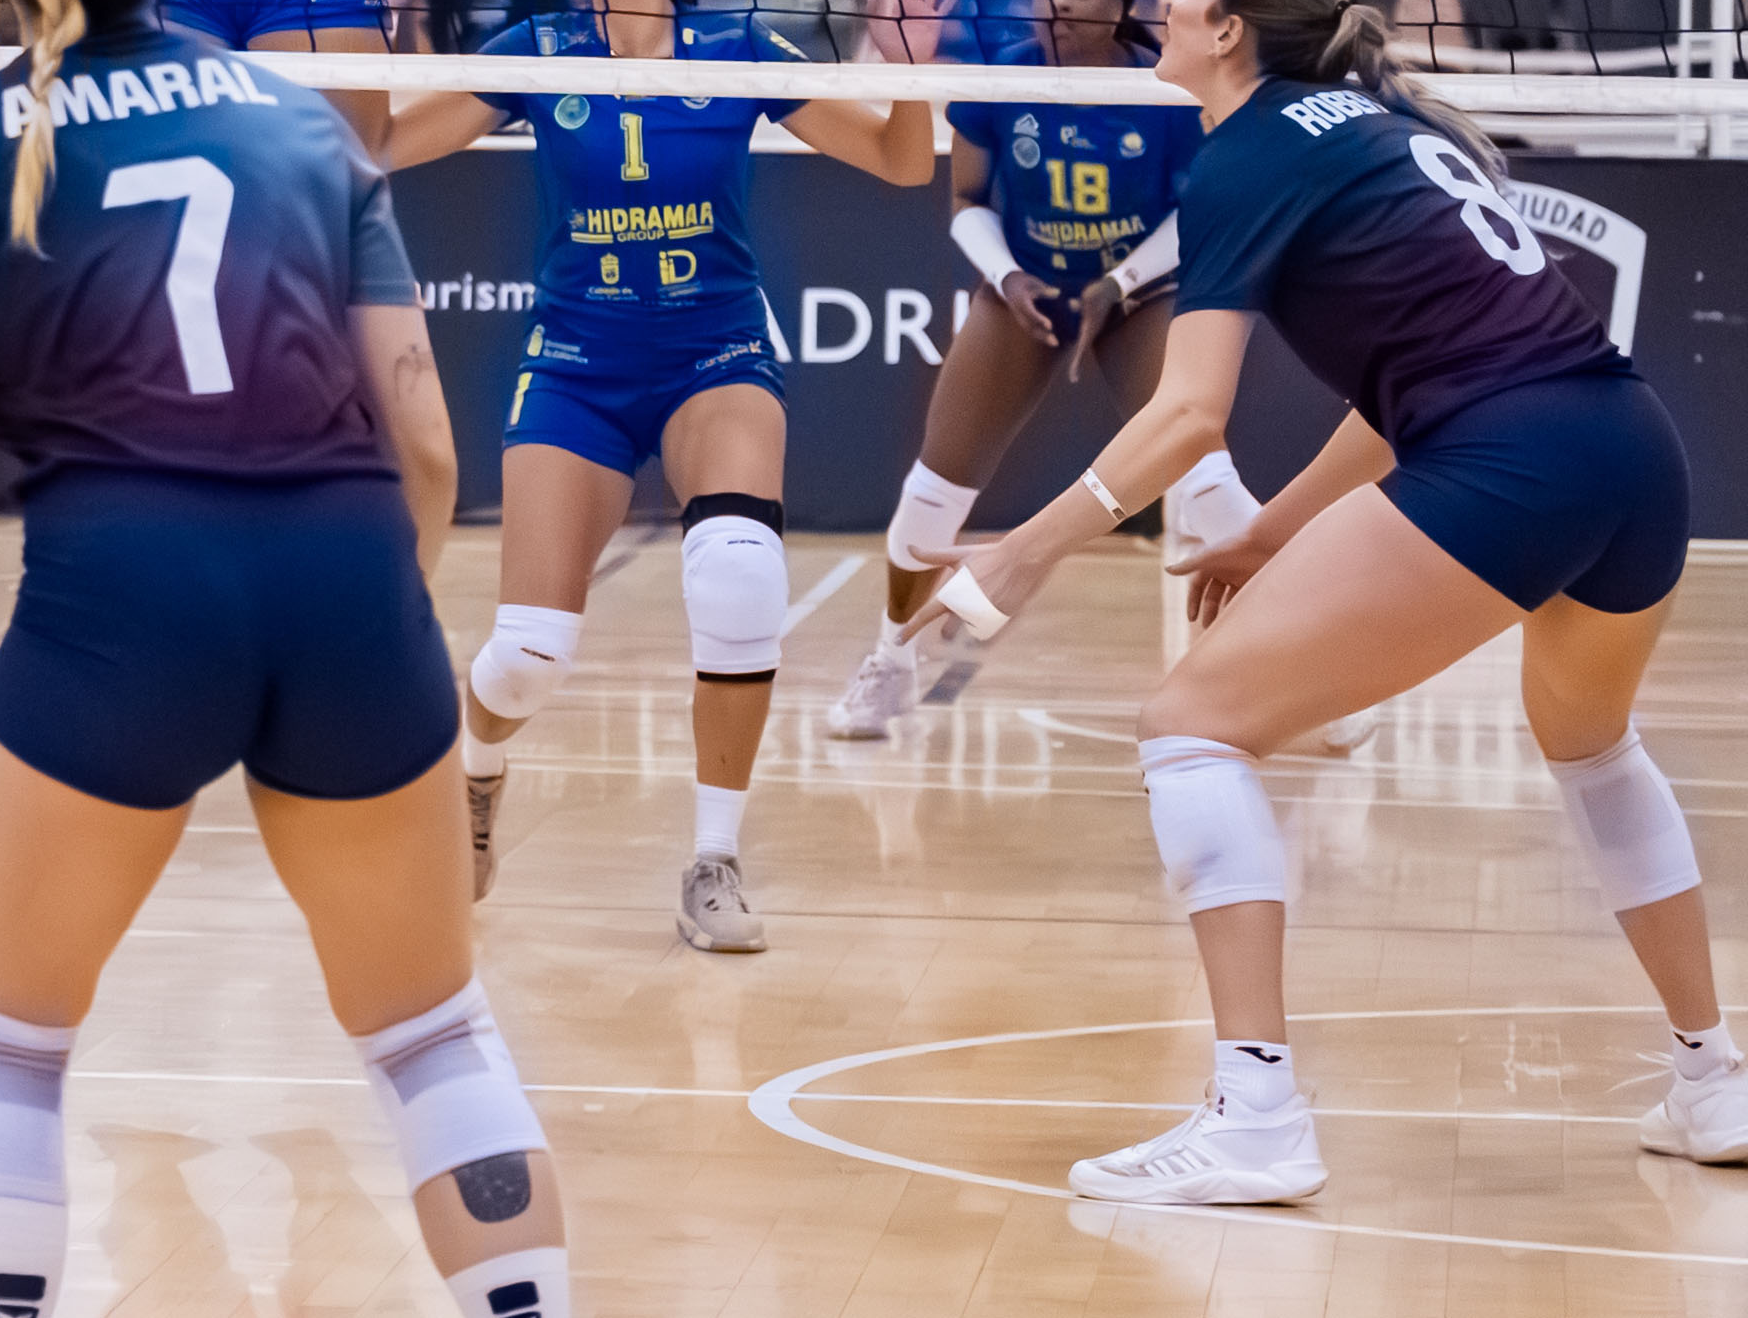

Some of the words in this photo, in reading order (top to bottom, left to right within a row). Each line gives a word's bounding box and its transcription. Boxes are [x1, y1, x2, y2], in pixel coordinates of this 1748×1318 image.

[1, 58, 279, 139] AMARAL
[620, 112, 650, 182] 1
[587, 201, 713, 234] HIDRAMAR
[1046, 158, 1110, 215] 18
[1408, 133, 1546, 276] 8
[617, 228, 665, 242] GROUP
[102, 156, 235, 395] 7
